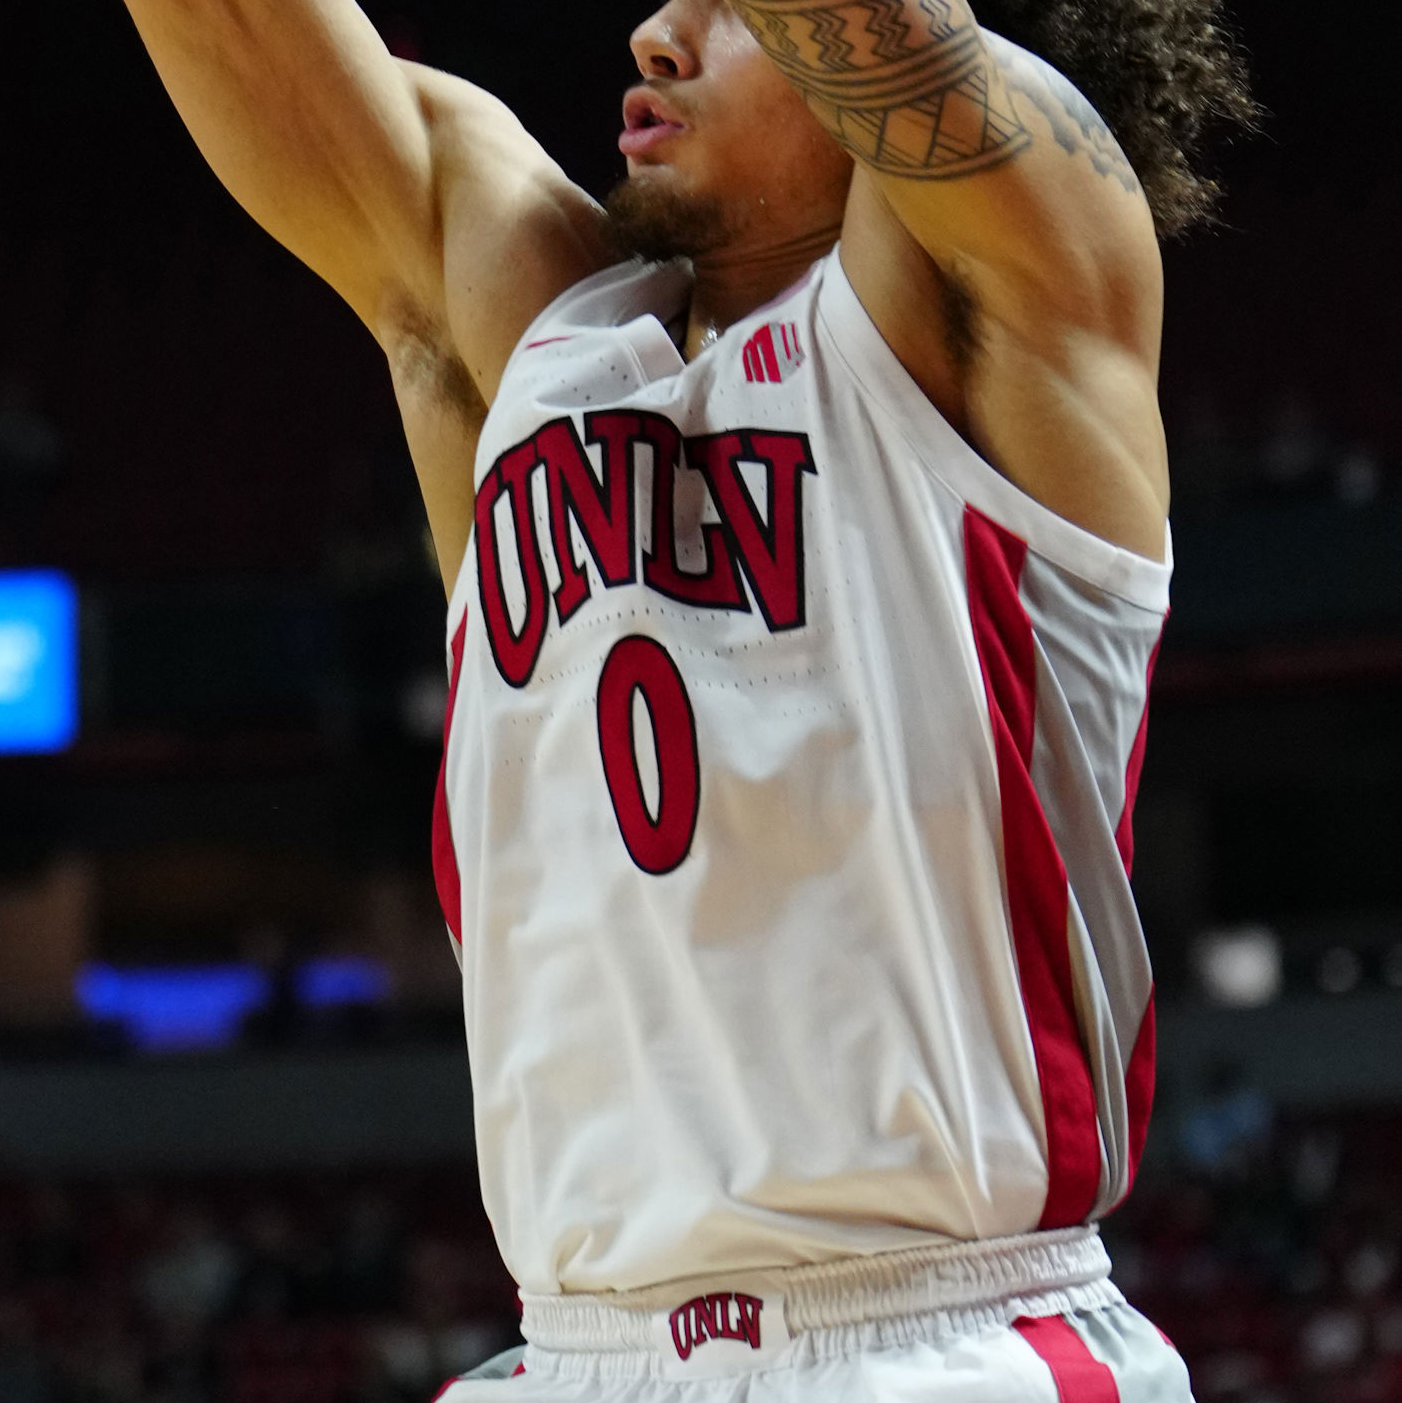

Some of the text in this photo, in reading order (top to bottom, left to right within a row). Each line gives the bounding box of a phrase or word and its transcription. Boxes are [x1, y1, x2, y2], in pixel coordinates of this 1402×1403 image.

[474, 409, 818, 689] UNLV
[598, 634, 700, 875] 0
[668, 1291, 764, 1362] UNLV
